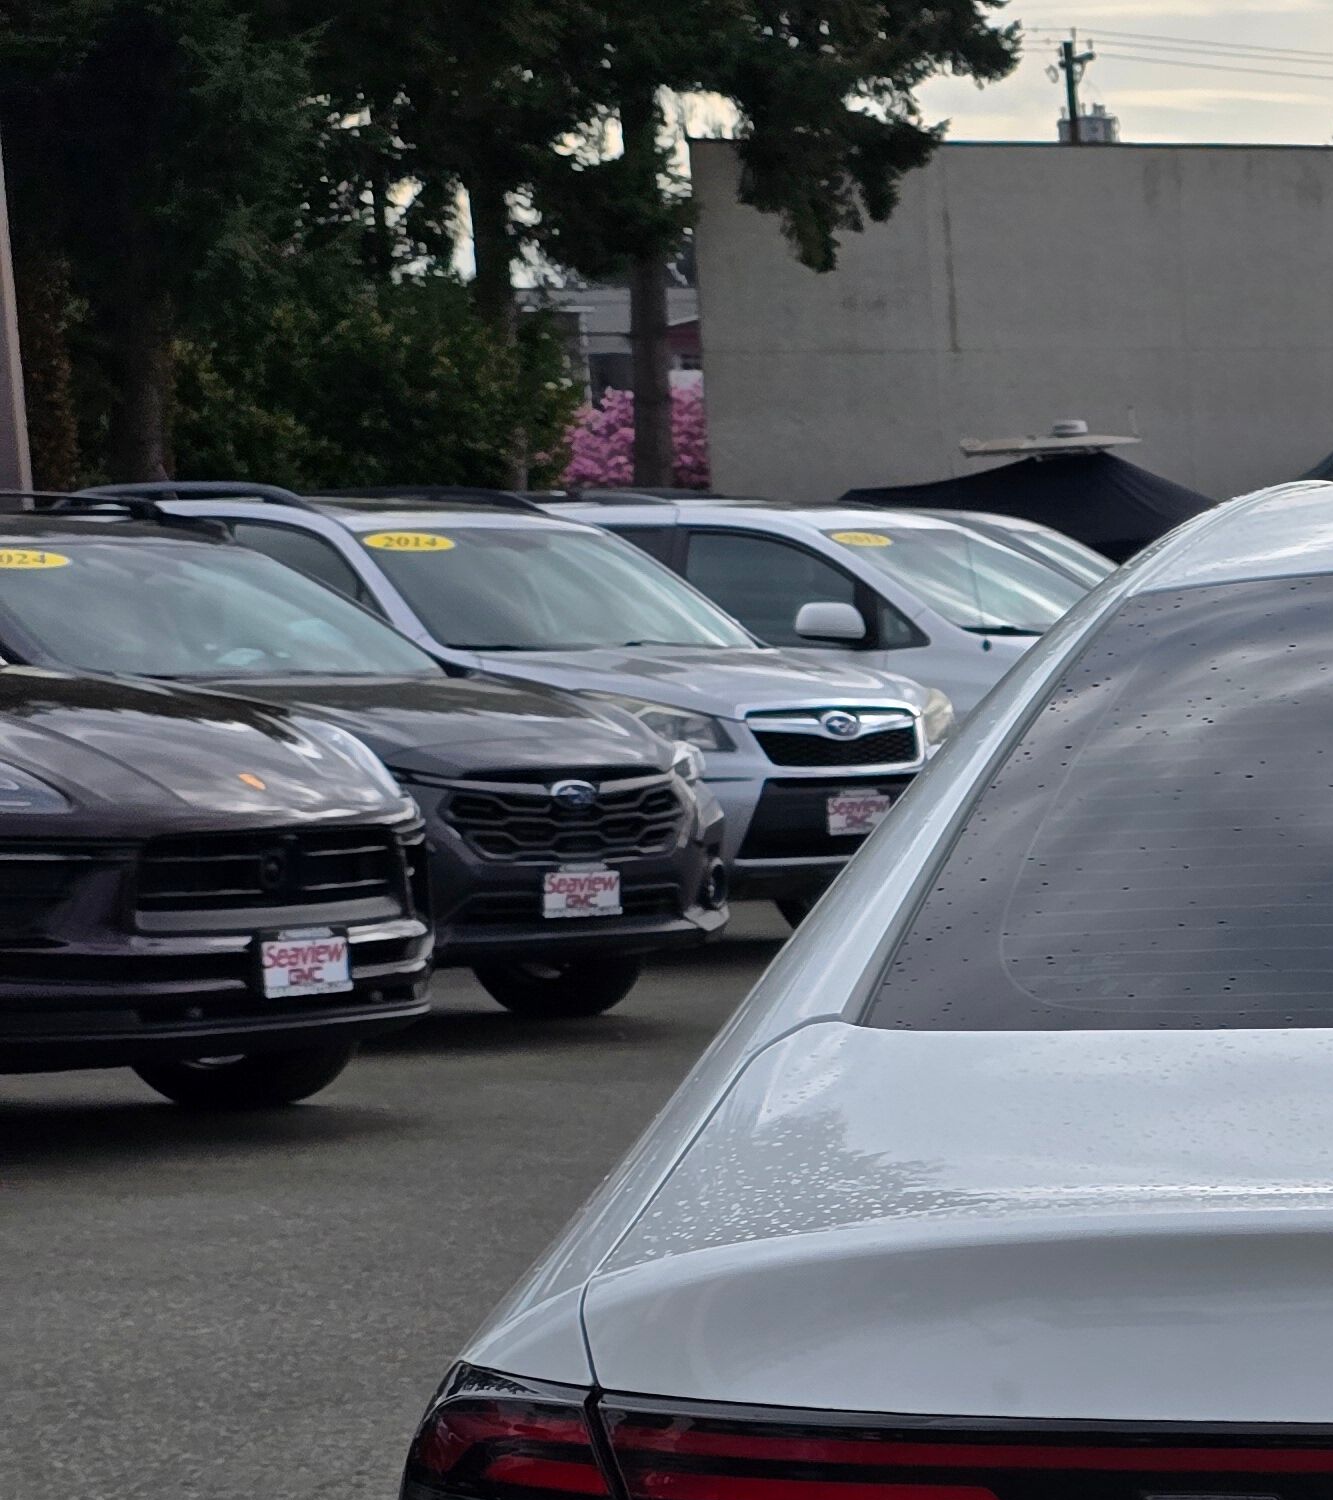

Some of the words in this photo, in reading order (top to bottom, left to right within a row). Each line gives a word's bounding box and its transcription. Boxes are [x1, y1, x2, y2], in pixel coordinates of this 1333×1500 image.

[545, 874, 619, 893] Seaview
[262, 943, 346, 968] Seaview
[288, 966, 325, 985] GMC
